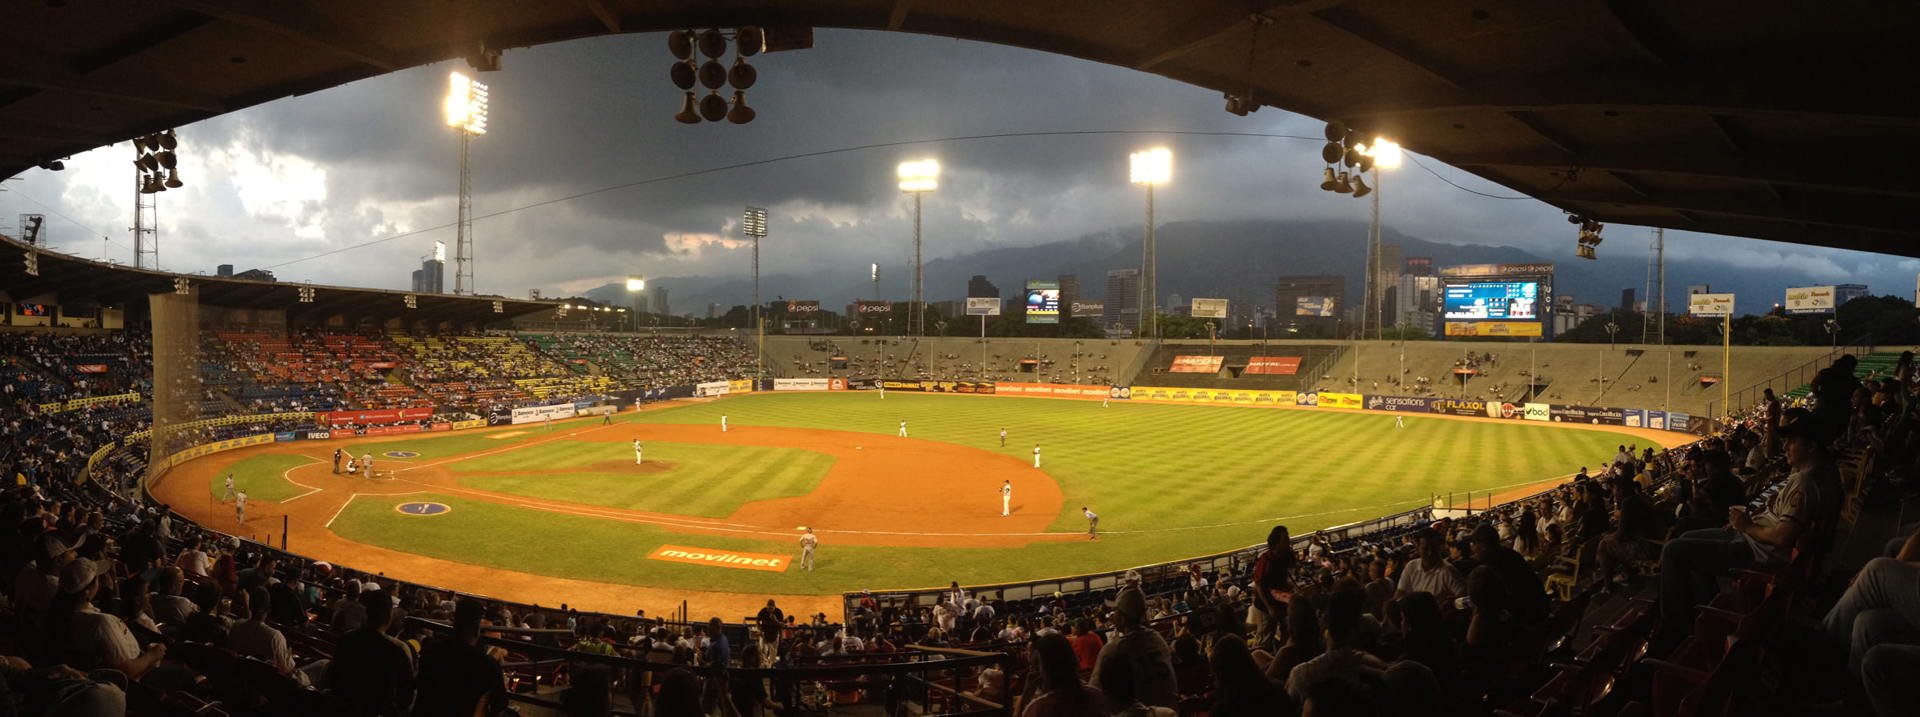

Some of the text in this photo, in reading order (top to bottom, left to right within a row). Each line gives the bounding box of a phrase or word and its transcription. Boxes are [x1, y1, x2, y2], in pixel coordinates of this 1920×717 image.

[796, 304, 819, 312] pepsi
[867, 304, 891, 312] pepsi
[1385, 397, 1425, 406] sensations
[1447, 400, 1485, 410] FLAXOL
[308, 432, 330, 440] IVECO
[659, 550, 782, 567] movilnet
